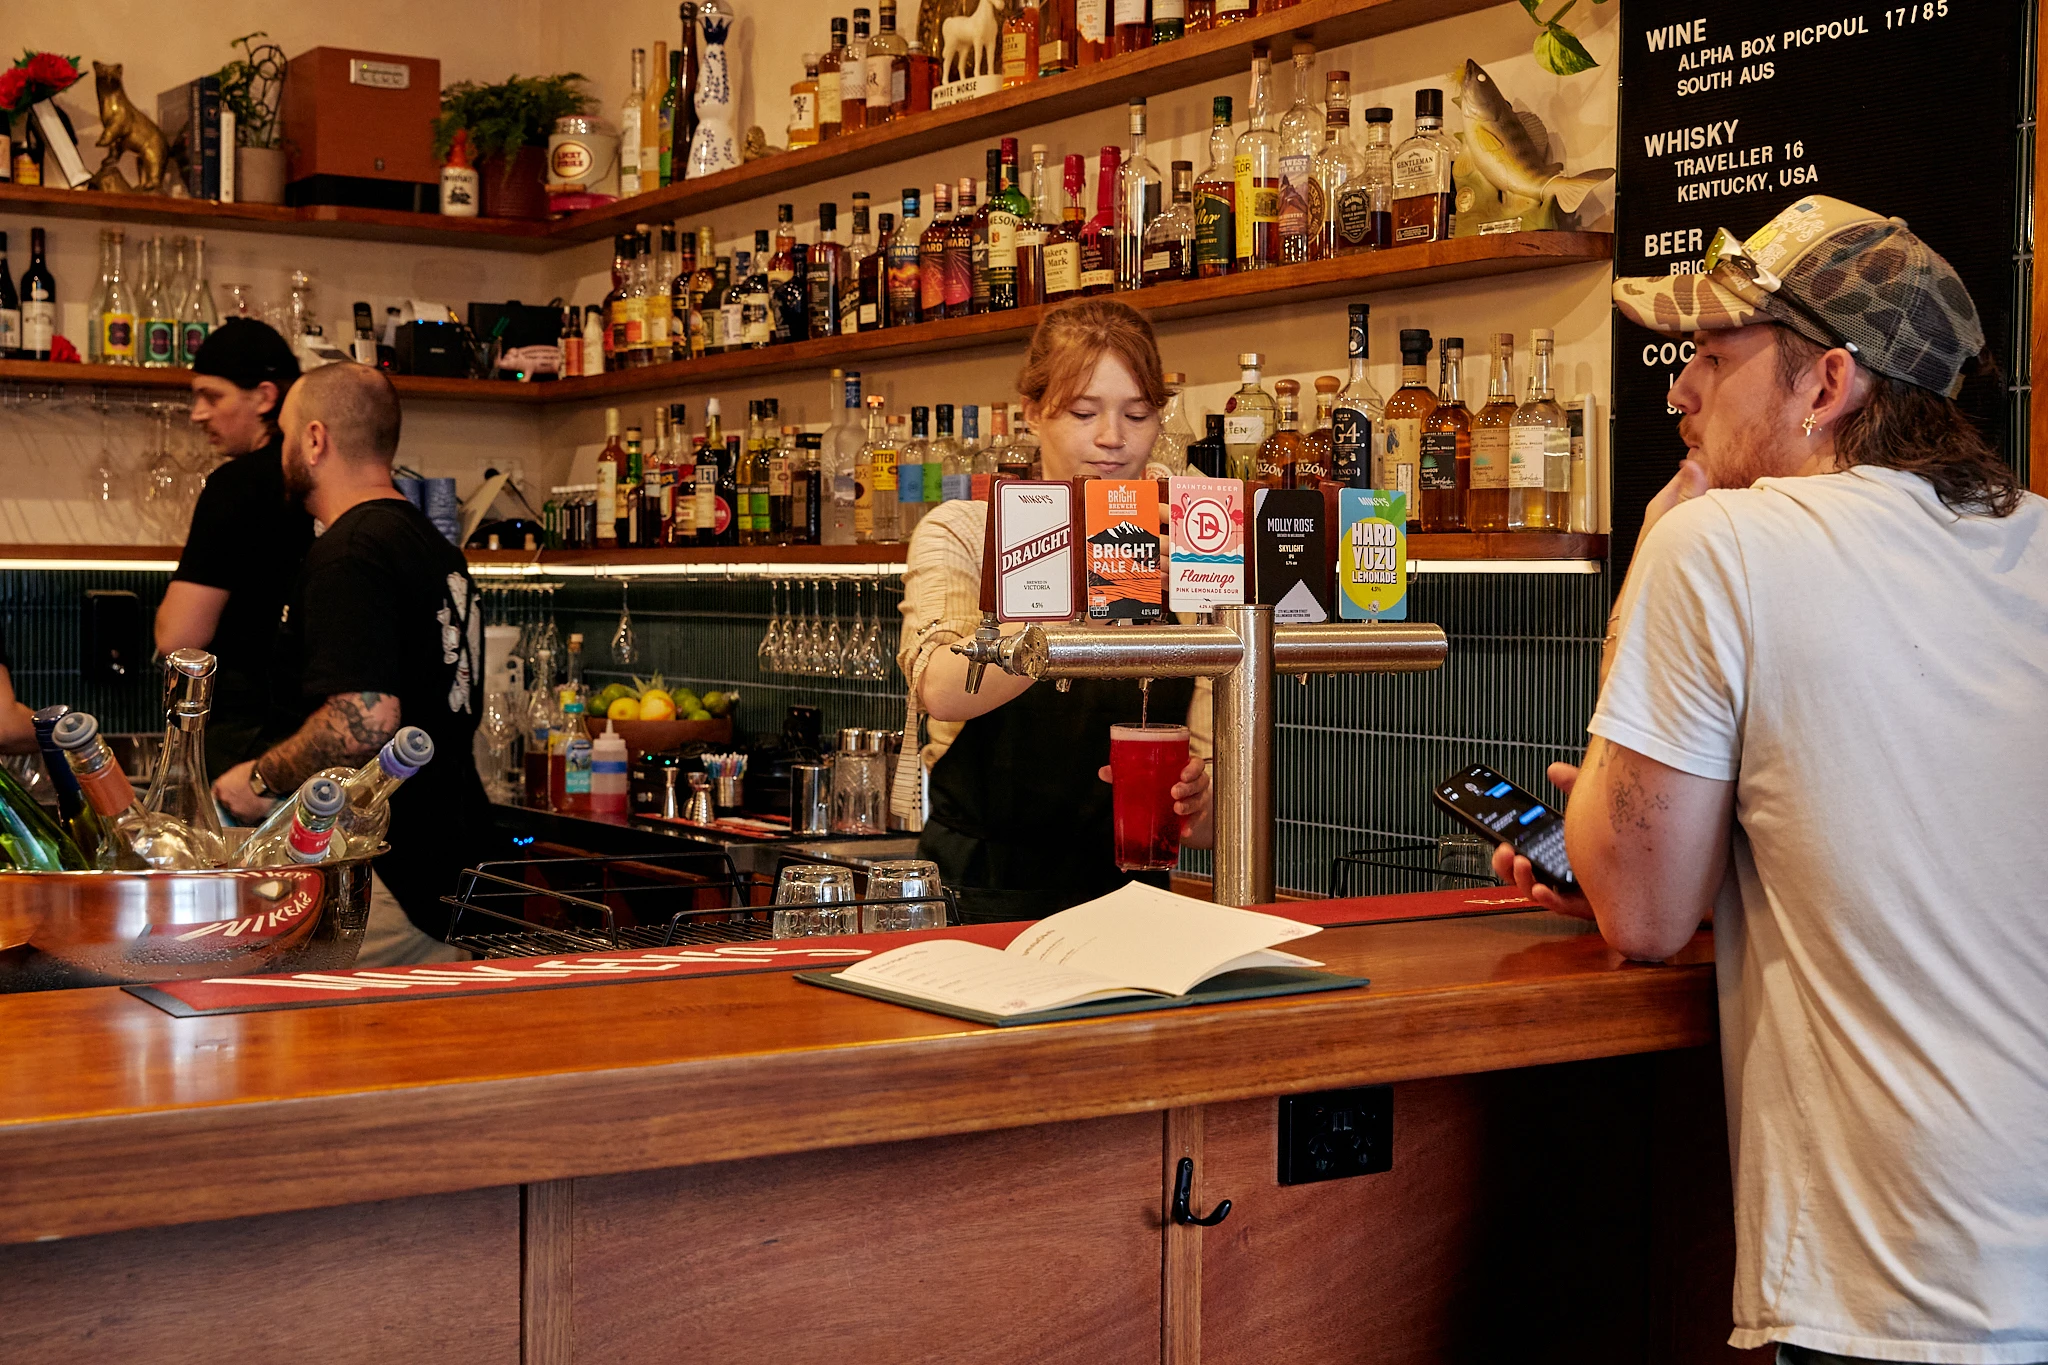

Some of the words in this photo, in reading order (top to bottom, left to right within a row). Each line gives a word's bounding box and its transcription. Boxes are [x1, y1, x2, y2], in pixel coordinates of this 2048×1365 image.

[1646, 18, 1707, 52] WINE
[1678, 44, 1735, 72] ALPHA
[1741, 34, 1776, 59] BOX
[1783, 15, 1869, 50] PICPOUL
[1885, 0, 1950, 30] 17/85
[1676, 69, 1733, 97] SOUTH
[1739, 62, 1775, 86] AUS
[934, 86, 954, 99] WHITE
[957, 81, 977, 94] HORSE
[1644, 118, 1740, 158] WHISKY
[1396, 156, 1434, 169] GENTLEMAN
[1674, 145, 1774, 178] TRAVELLER
[1784, 140, 1805, 160] 16
[1407, 165, 1423, 175] JACK
[1677, 172, 1774, 203] KENTUCKY,
[1779, 164, 1819, 187] USA
[1644, 228, 1704, 257] BEER
[1047, 257, 1069, 267] Mark
[1333, 421, 1357, 444] G4
[1108, 490, 1137, 503] BRIGHT
[1176, 483, 1213, 491] DAINTON
[1018, 494, 1054, 505] MIKEY'S
[1357, 496, 1390, 507] MIKEY'S
[1267, 518, 1293, 532] MOLLY
[1293, 518, 1315, 532] ROSE
[1351, 522, 1397, 547] HARD
[1002, 527, 1070, 572] DRAUGHT
[1092, 543, 1156, 559] BRIGHT
[1278, 544, 1304, 553] SKYLIGHT
[1093, 560, 1127, 574] PALE
[1131, 560, 1156, 573] ALE
[1352, 546, 1397, 571] YUZU
[1180, 569, 1235, 589] Flamingo
[1351, 570, 1397, 584] LEMONADE
[201, 946, 873, 990] MIKEY'S
